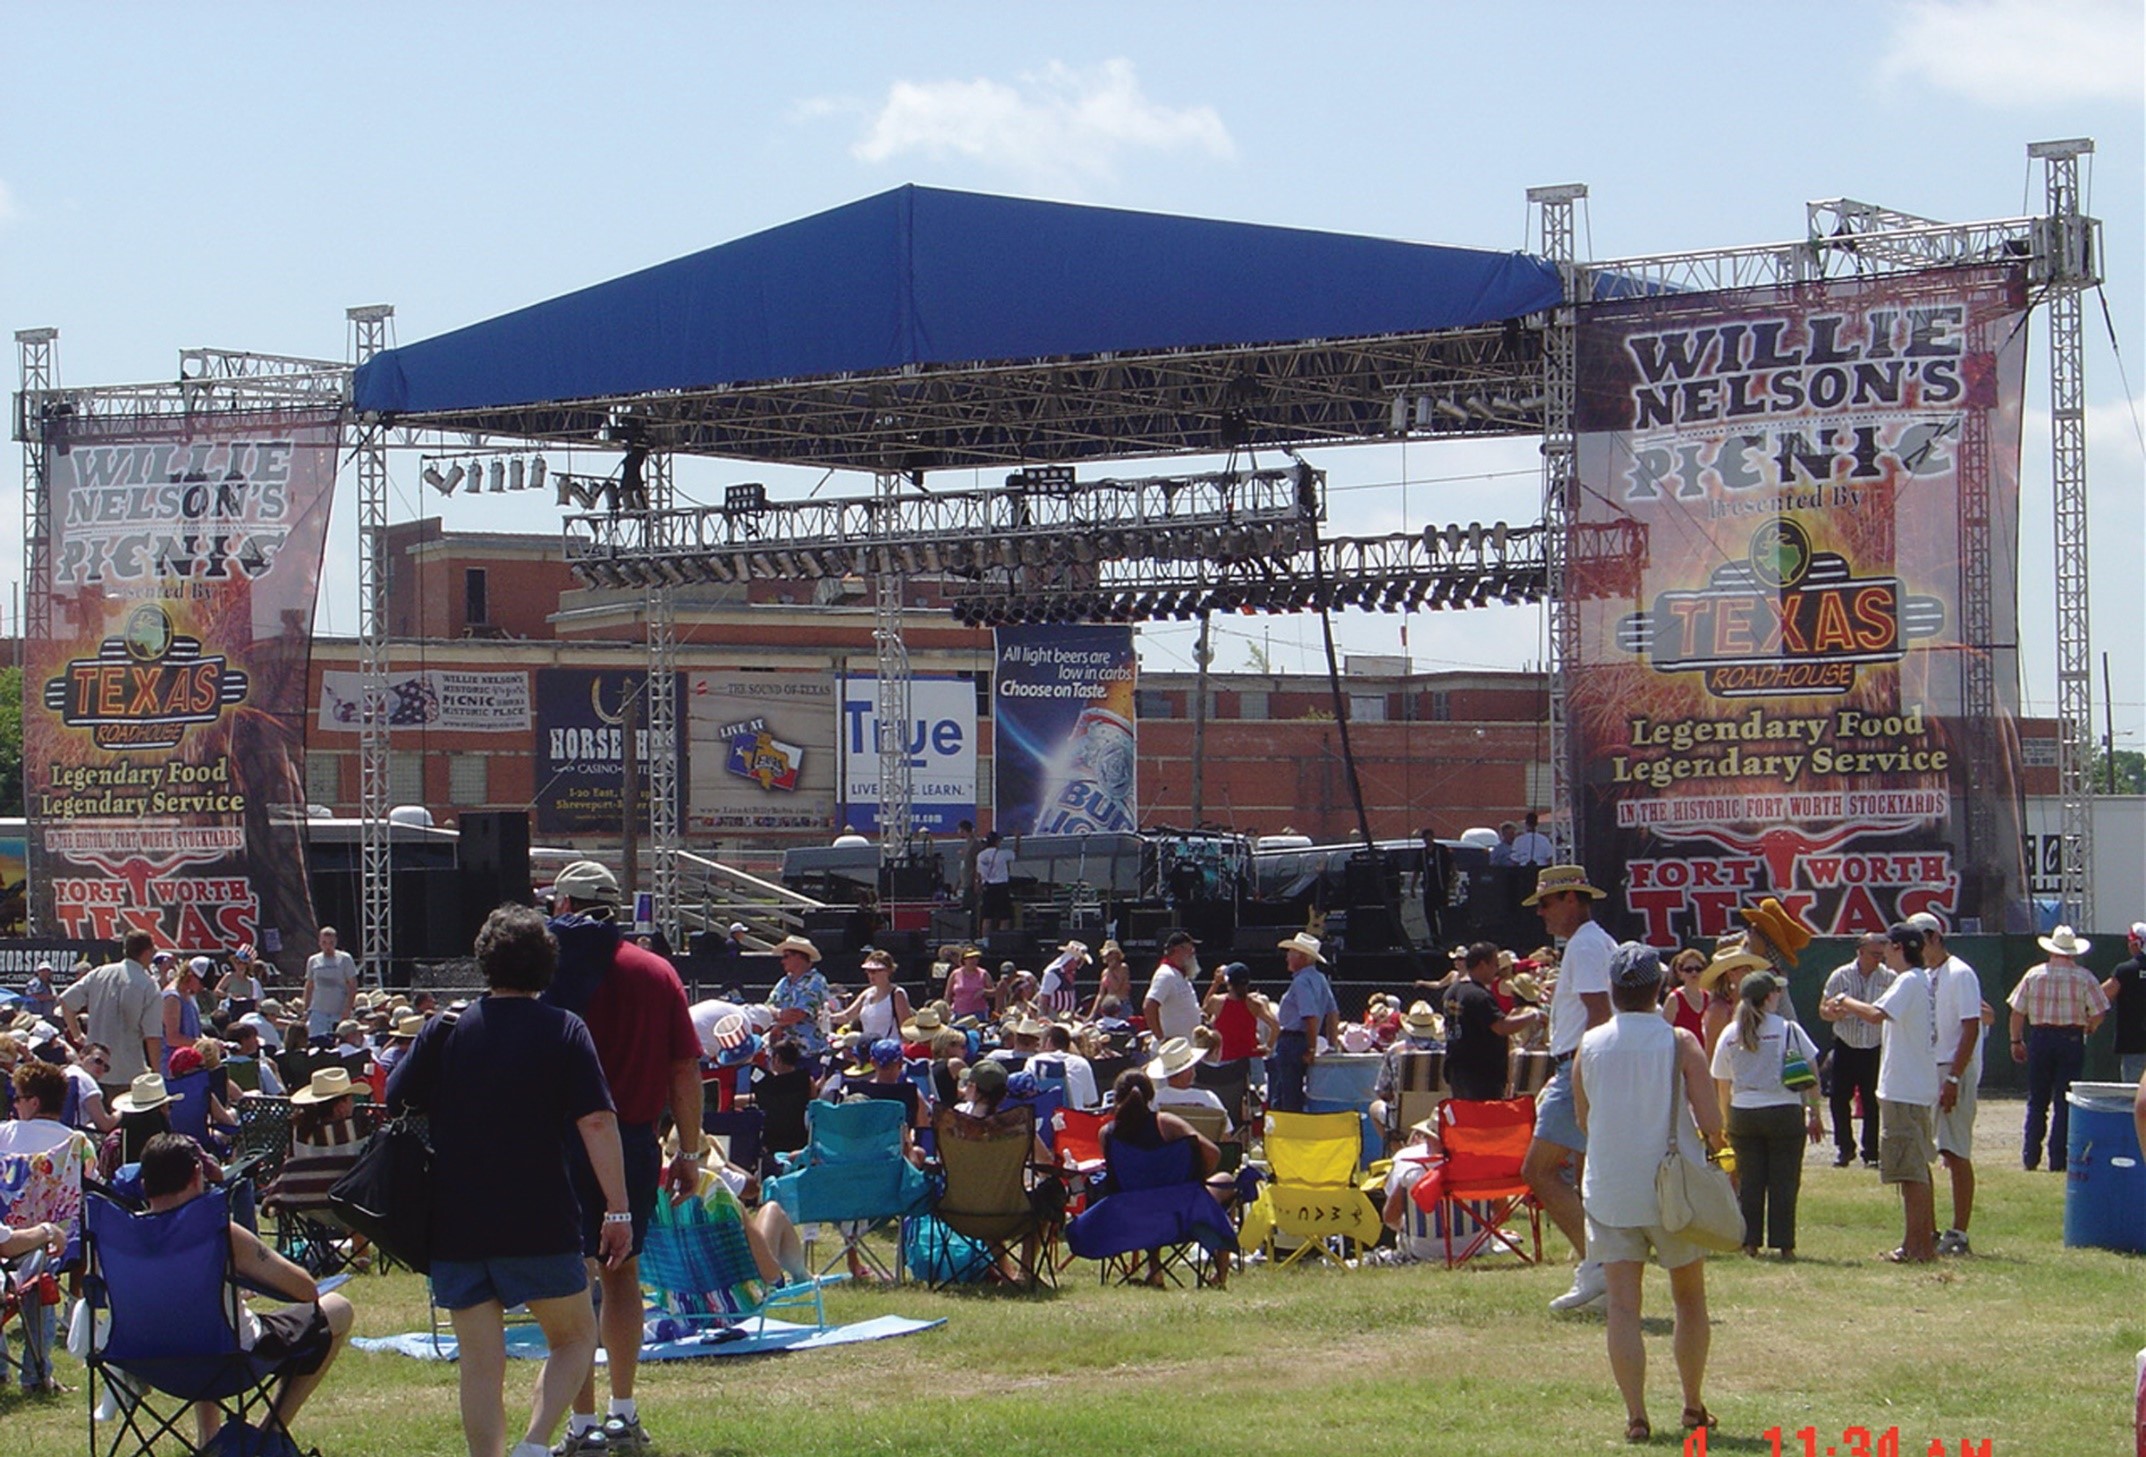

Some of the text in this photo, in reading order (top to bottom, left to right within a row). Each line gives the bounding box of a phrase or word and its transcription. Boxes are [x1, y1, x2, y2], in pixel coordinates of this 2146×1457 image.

[1626, 305, 1966, 383] WILLIE
[1634, 358, 1962, 431] NELSON'S
[70, 440, 294, 486] WILLIE
[1622, 417, 1962, 501] PICNIC
[66, 483, 288, 524] NELSON'S
[1832, 486, 1862, 512] By
[55, 530, 290, 585] PICNIC
[1670, 587, 1896, 655] TEXAS
[1003, 647, 1111, 666] All light beers are
[1058, 665, 1083, 679] low
[1085, 666, 1098, 680] in
[1712, 664, 1851, 689] ROADHOUSE
[73, 664, 219, 715] TEXAS
[442, 695, 495, 707] PICNIC
[728, 684, 746, 694] THE
[800, 684, 831, 695] TEXAS
[1000, 680, 1107, 699] Choose on Taste.
[96, 724, 182, 742] ROADHOUSE
[720, 722, 747, 738] LIVE
[1632, 704, 1925, 749] Legendary Food
[51, 757, 228, 790] Legendary Food
[1613, 747, 1948, 787] Legendary Service
[922, 784, 965, 796] LEARN.
[41, 793, 245, 820] Legendary Service
[1620, 793, 1944, 823] IN THE HISTORIC FORT WORTH STOCKYARDS
[140, 831, 173, 848] WORTH
[177, 830, 242, 848] STOCKYARDS
[1627, 857, 1759, 887] FORT
[53, 880, 125, 904] FORT
